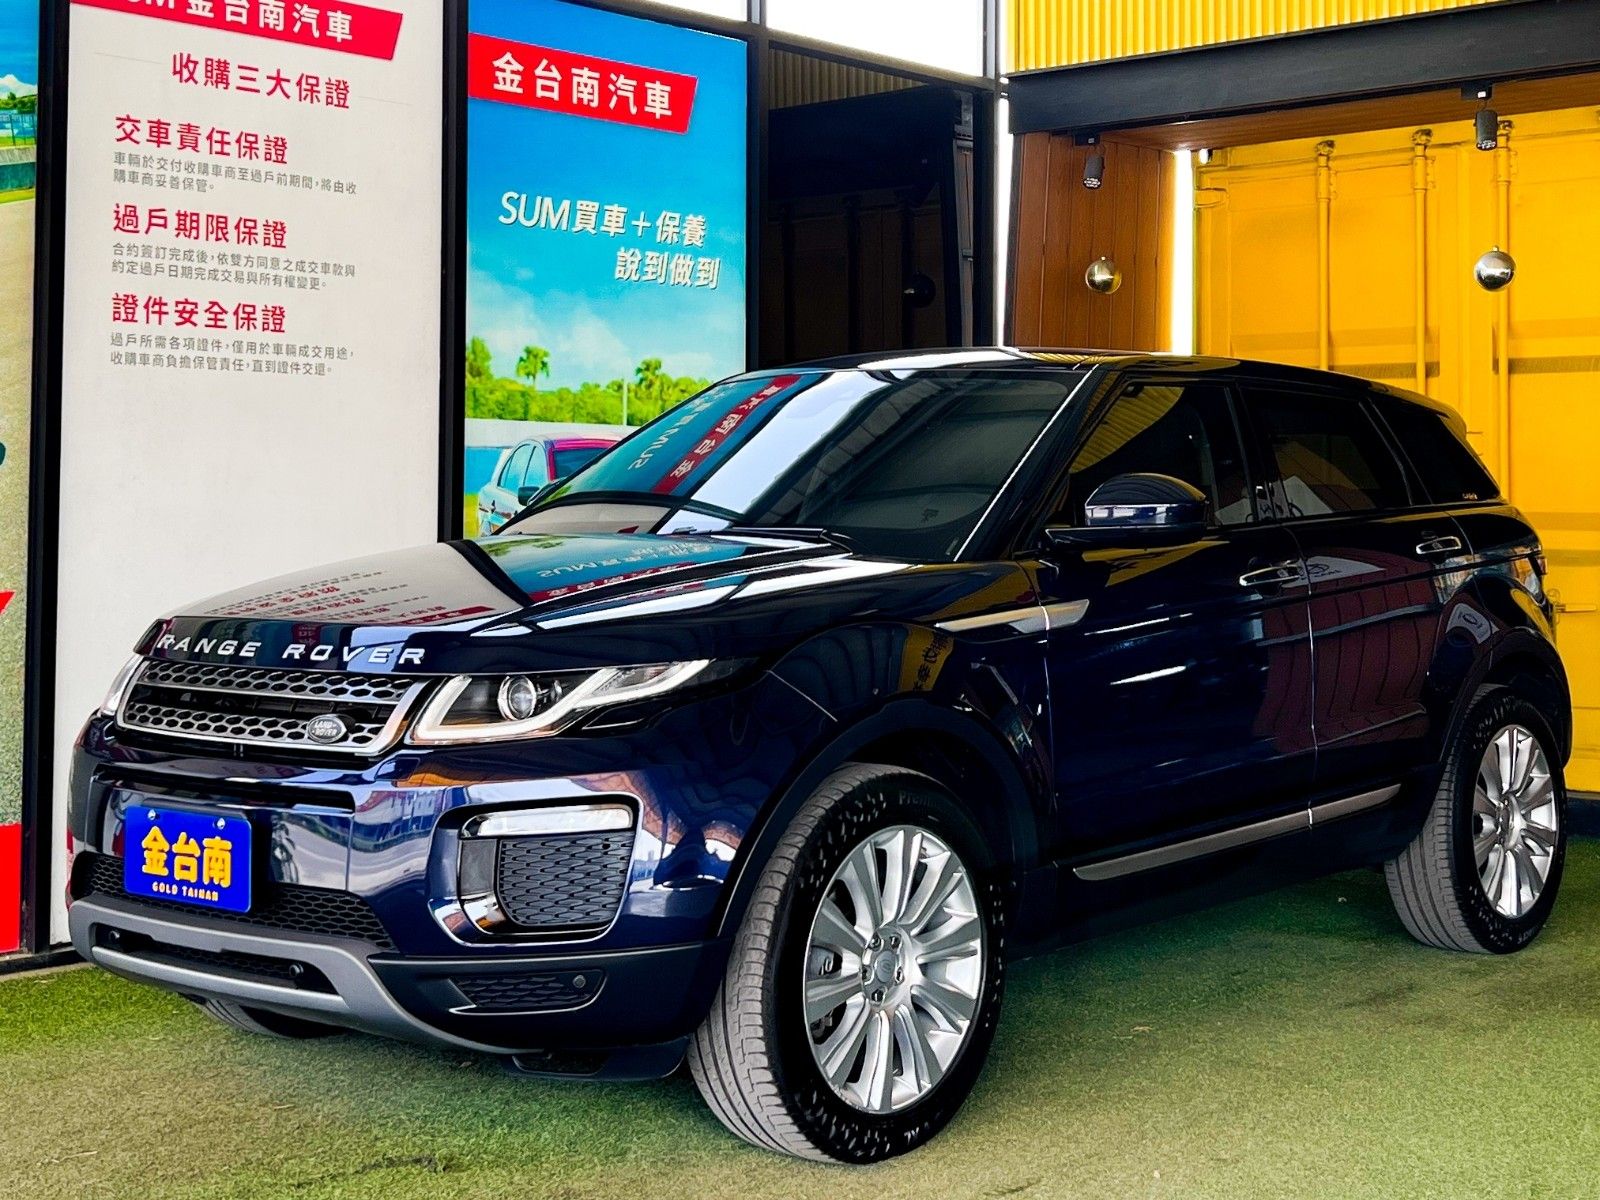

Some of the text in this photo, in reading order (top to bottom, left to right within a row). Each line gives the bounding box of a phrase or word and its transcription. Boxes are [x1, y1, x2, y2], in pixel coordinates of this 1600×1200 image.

[171, 52, 350, 109] 收購三大保證
[491, 51, 673, 119] 金台南汽車
[115, 114, 288, 165] 交車責任保證
[113, 203, 287, 248] 過戶期限保證
[614, 247, 720, 289] 說到做到
[112, 292, 286, 333] 證件安全保證
[156, 633, 425, 665] RANGE ROVER
[141, 825, 232, 888] 金台南
[152, 881, 219, 901] GOLD TAINAN
